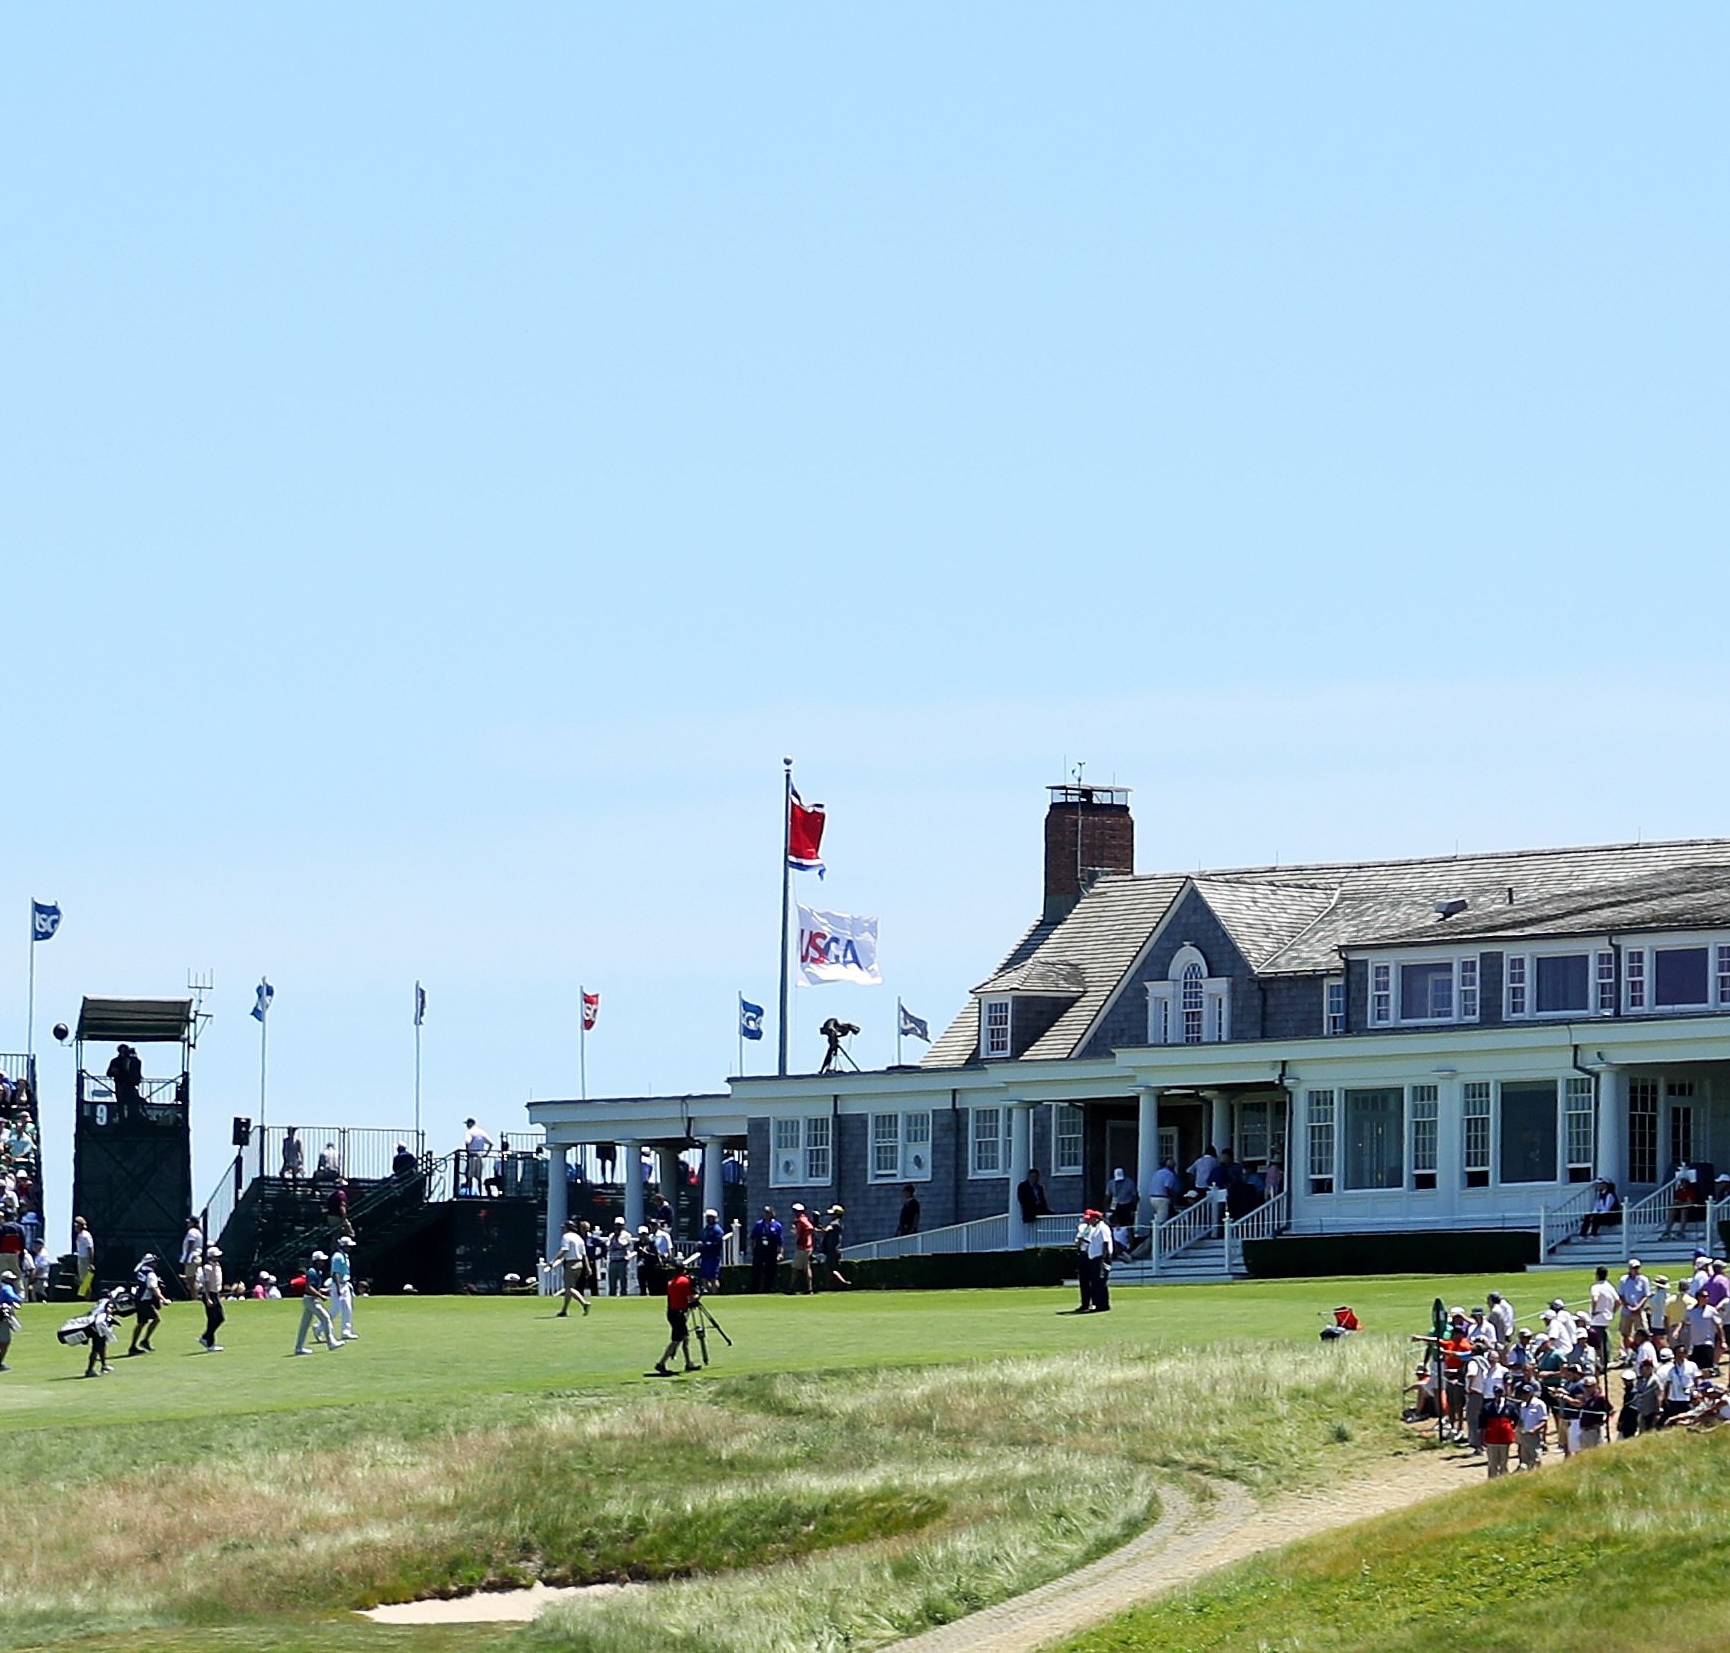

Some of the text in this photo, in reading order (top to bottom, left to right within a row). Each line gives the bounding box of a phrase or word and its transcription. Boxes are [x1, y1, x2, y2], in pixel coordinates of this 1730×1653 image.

[35, 911, 59, 933] USG
[801, 929, 864, 971] USGA
[95, 1104, 108, 1126] 9
